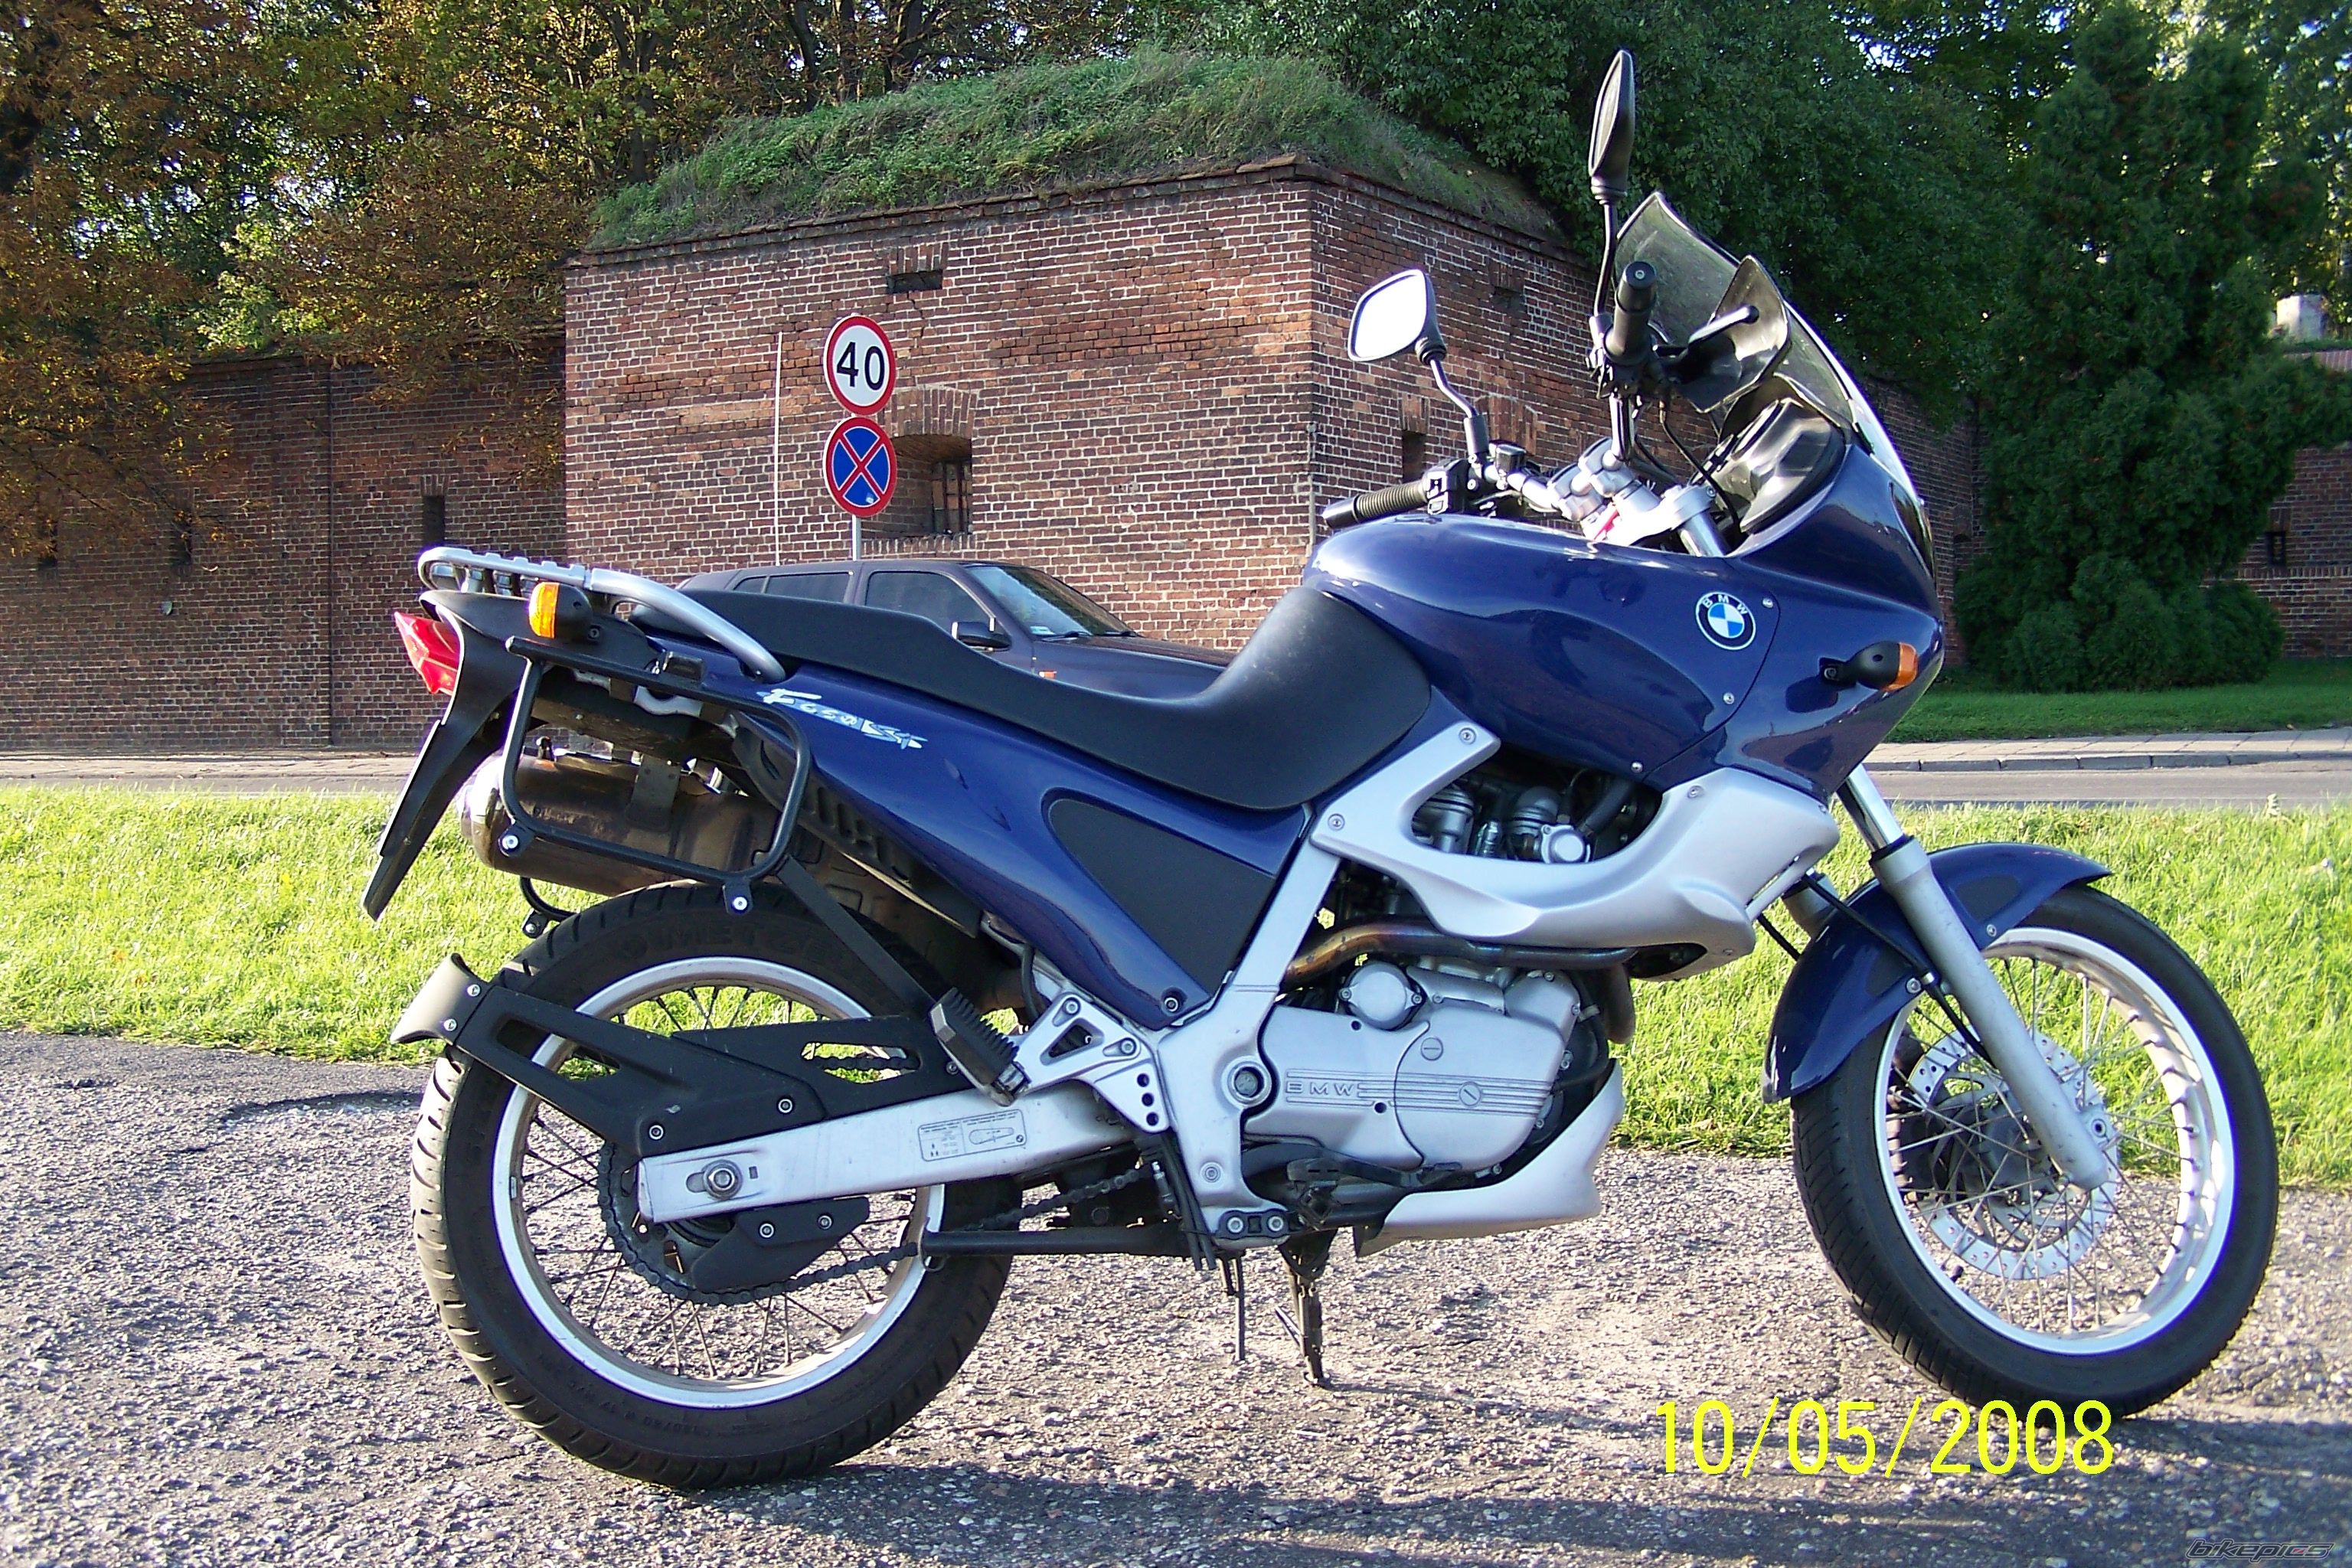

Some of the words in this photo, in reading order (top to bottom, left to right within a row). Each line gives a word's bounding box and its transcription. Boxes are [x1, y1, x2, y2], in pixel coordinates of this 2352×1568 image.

[836, 341, 885, 391] 40
[1702, 594, 1749, 615] BMW
[1285, 1080, 1354, 1096] BMW
